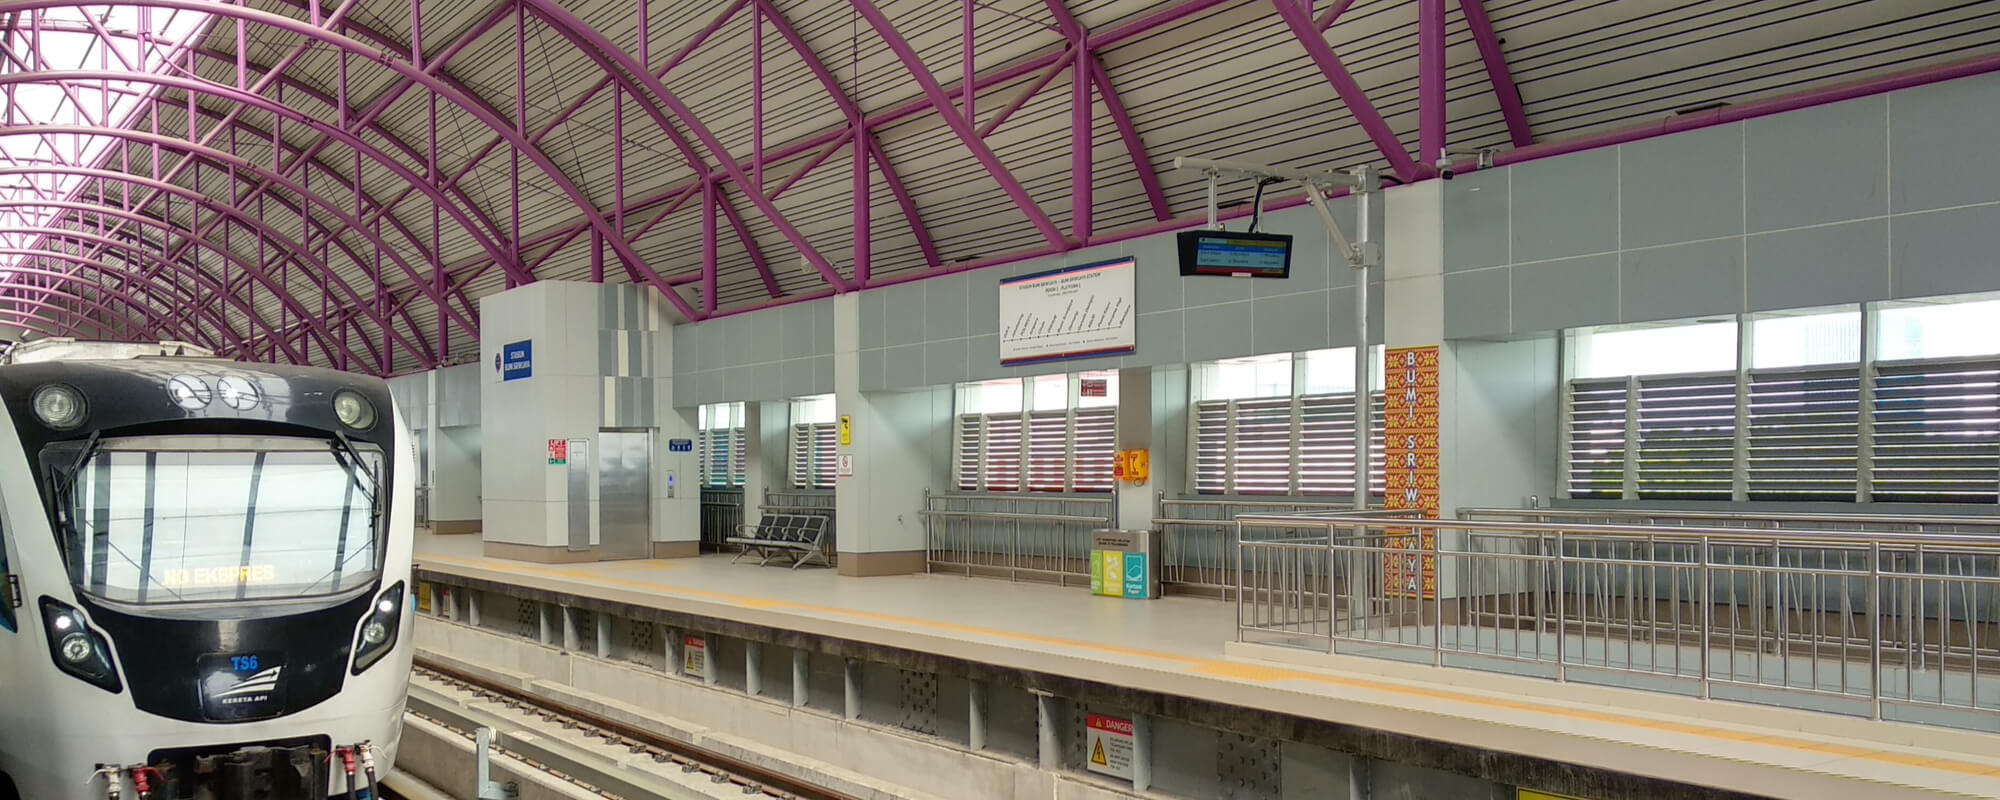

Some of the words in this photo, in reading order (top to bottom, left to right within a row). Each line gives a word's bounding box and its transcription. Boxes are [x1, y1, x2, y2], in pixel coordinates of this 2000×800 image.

[1405, 351, 1417, 419] BUMI
[1405, 435, 1418, 590] SRIWAYA
[231, 655, 259, 671] TS6
